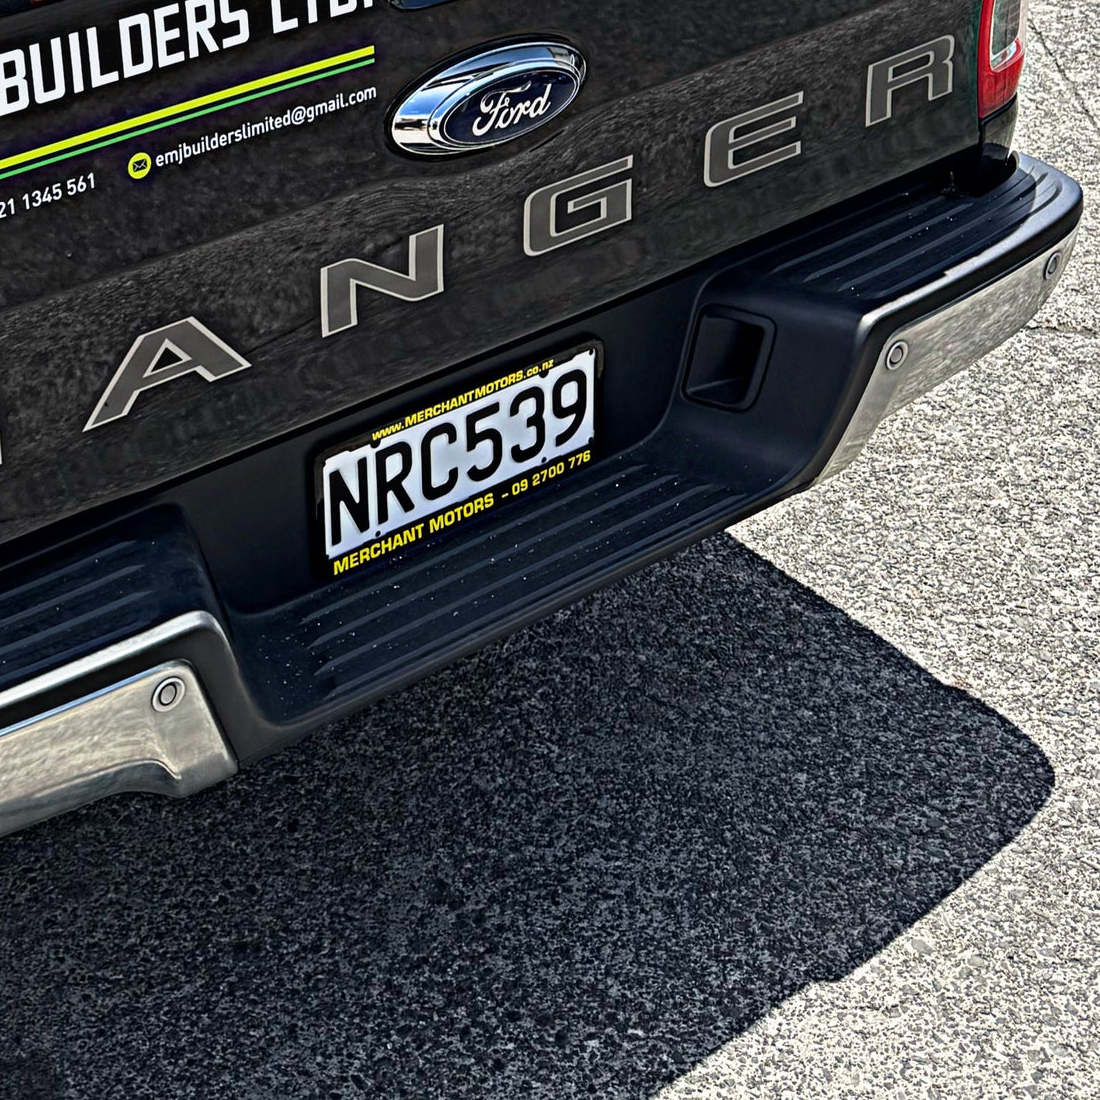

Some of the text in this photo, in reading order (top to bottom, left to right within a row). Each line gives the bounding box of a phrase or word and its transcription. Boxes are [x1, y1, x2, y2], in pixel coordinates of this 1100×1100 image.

[156, 86, 376, 167] emjbuilderslimited@gmail.com
[472, 80, 552, 136] Ford
[22, 183, 62, 210] 1345
[67, 172, 96, 198] 561
[372, 359, 554, 440] www.MERCHANTMOTORS.co.nz
[329, 368, 587, 546] NRC539
[333, 523, 424, 575] MERCHANT
[429, 493, 494, 533] MOTORS
[512, 475, 528, 496] 09
[532, 462, 564, 486] 2700
[568, 450, 591, 470] 776
